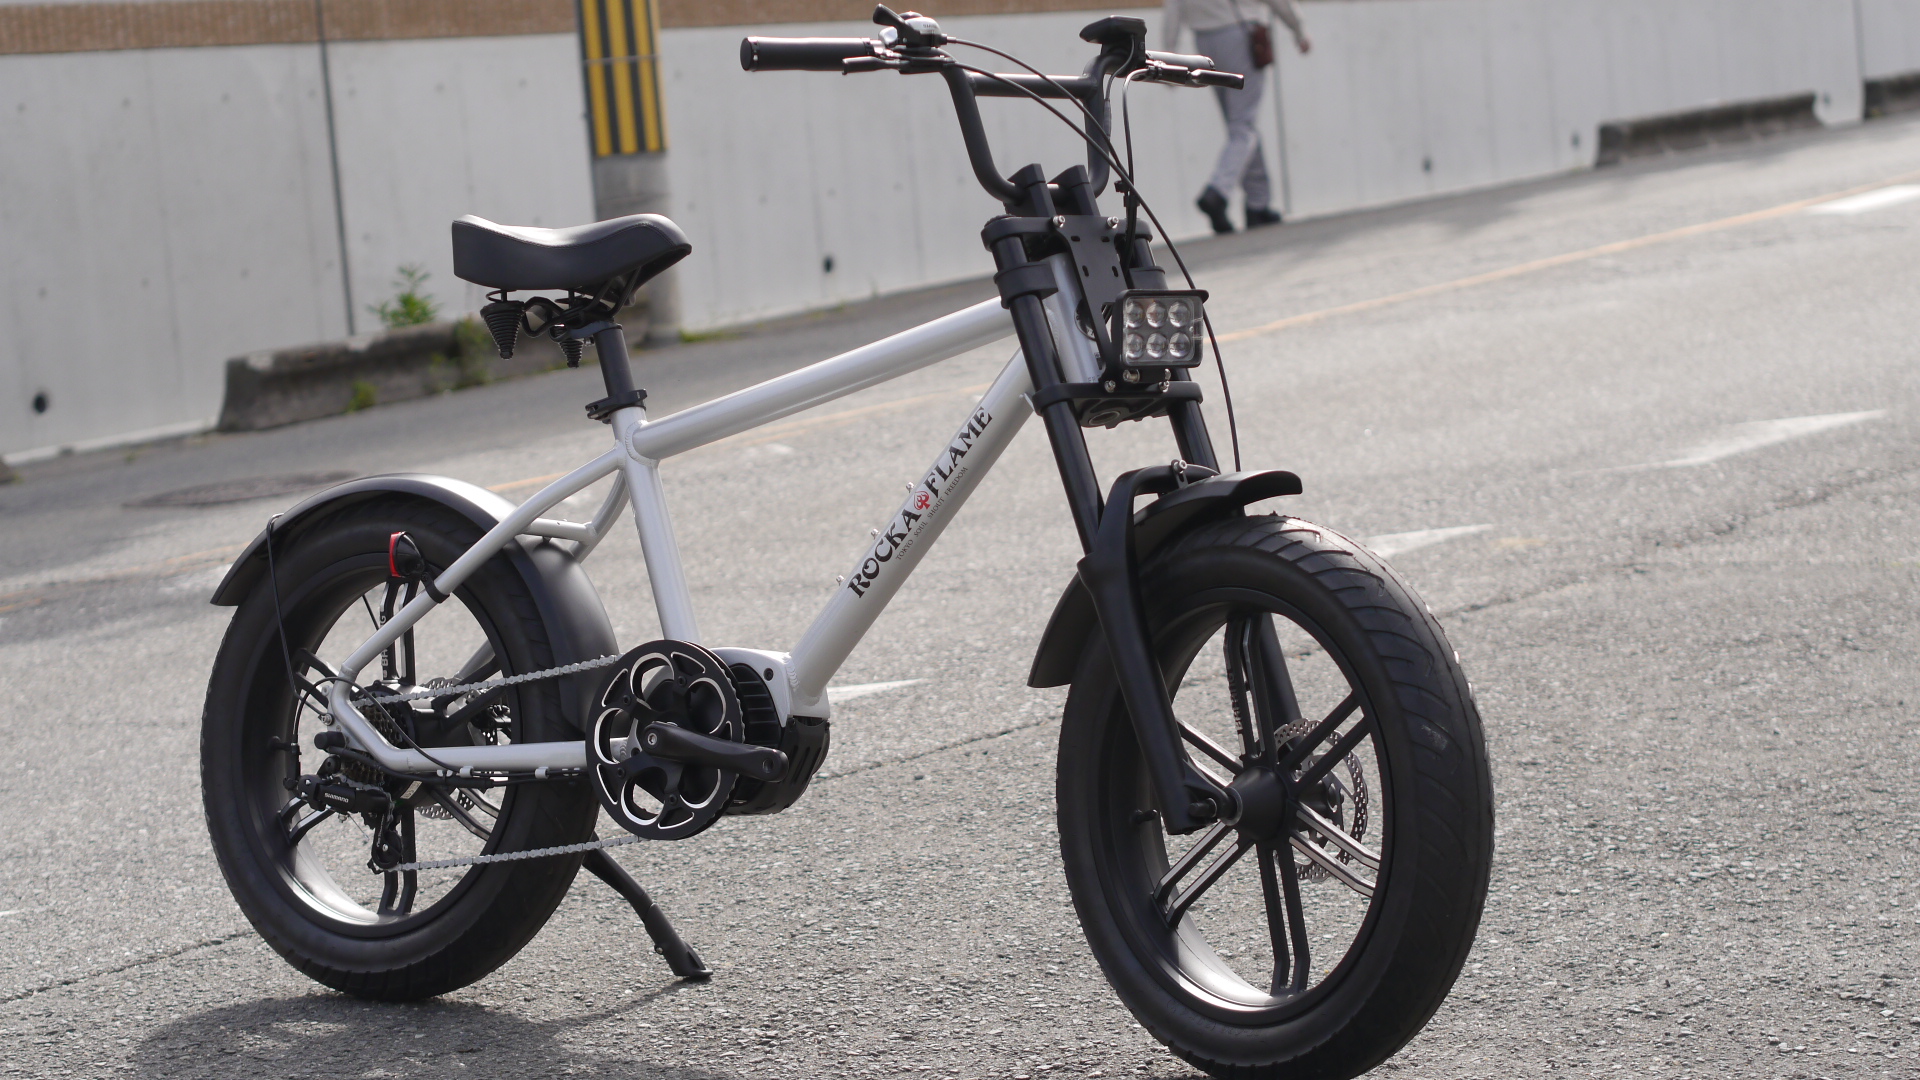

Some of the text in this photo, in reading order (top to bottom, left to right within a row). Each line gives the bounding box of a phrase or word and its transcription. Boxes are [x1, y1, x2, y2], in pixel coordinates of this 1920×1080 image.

[847, 406, 993, 599] ROCKA FLAME
[895, 539, 914, 560] TOKYO
[913, 521, 928, 537] SOUL
[945, 467, 968, 496] FREEDOM
[324, 792, 349, 803] SHIMANO
